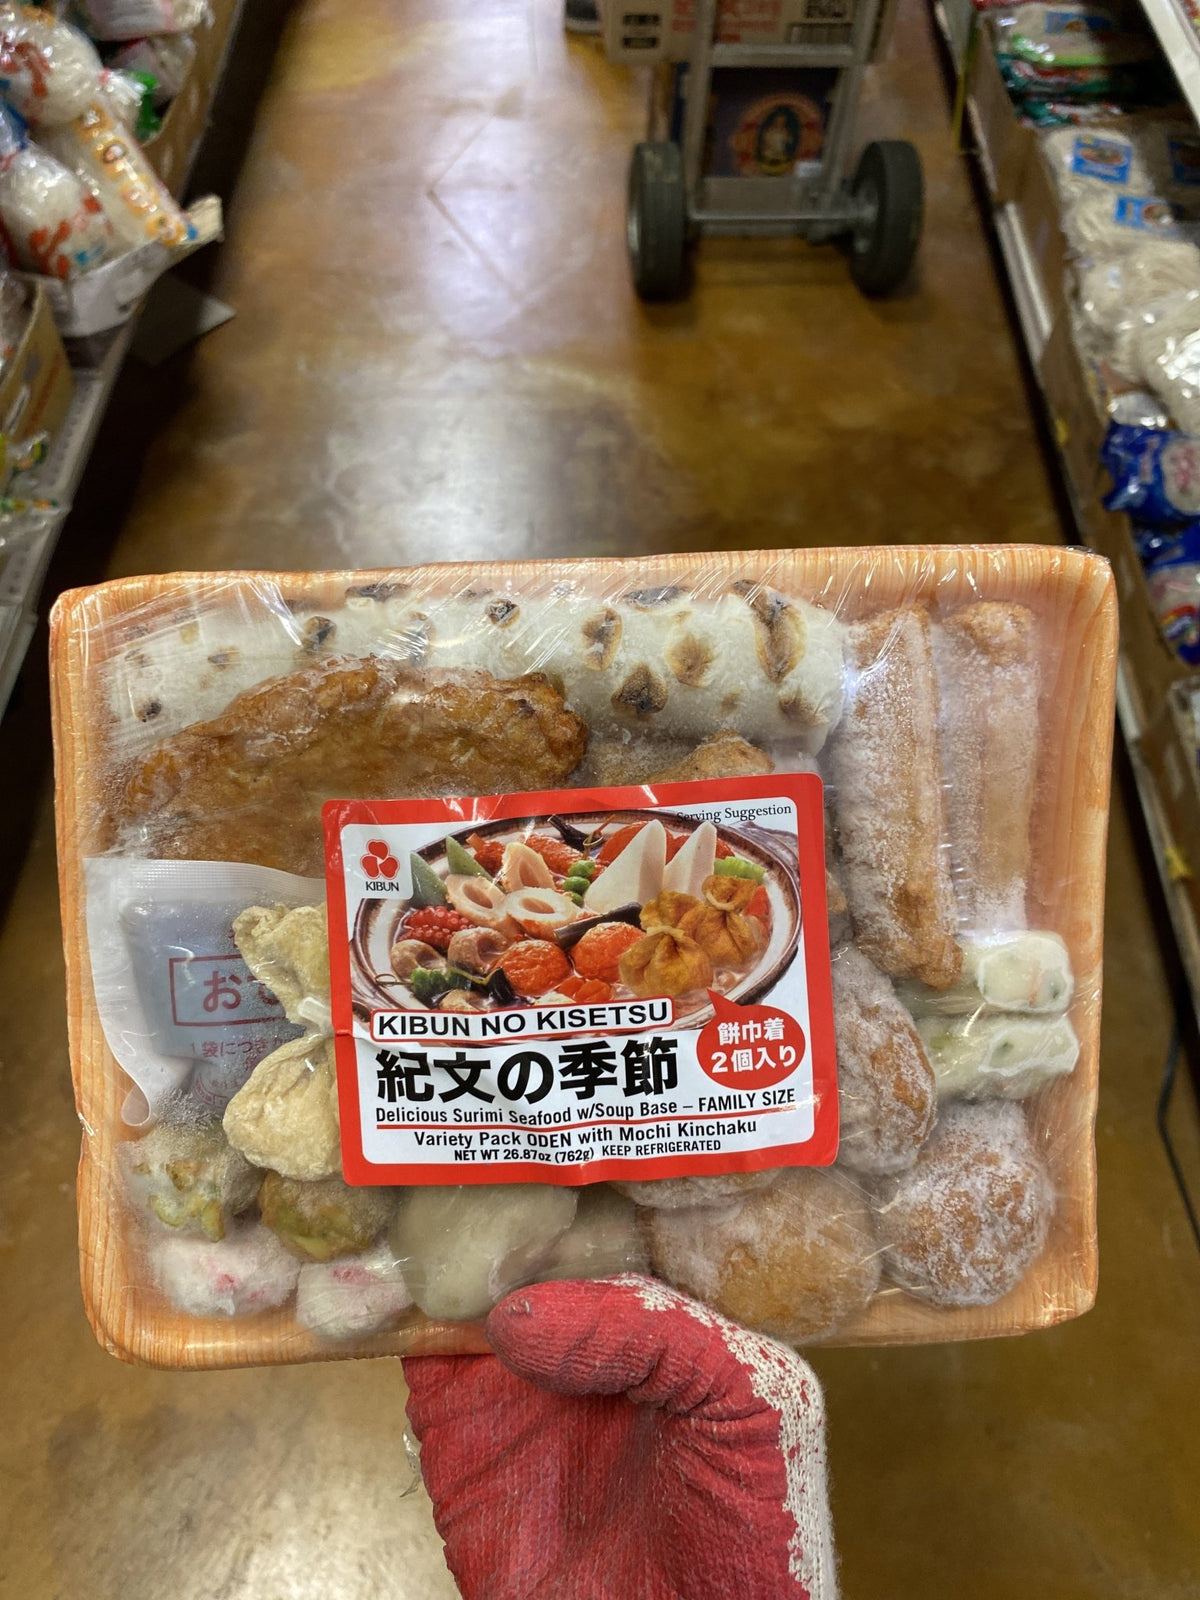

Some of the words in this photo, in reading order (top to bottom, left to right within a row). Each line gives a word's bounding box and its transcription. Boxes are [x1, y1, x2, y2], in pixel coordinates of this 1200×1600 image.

[677, 810, 722, 823] Serving
[725, 804, 792, 821] Suggestion
[366, 881, 399, 891] KIBUN
[378, 1015, 470, 1036] KIBUN
[481, 1013, 526, 1036] NO
[537, 1002, 667, 1030] KISETSU
[375, 1036, 678, 1104] 紀文の季節
[376, 1107, 447, 1122] Delicious
[453, 1108, 503, 1123] Surimi
[509, 1107, 571, 1125] Seafood
[577, 1103, 634, 1121] w/Soup
[640, 1101, 677, 1117] Base
[699, 1093, 757, 1112] FAMILY
[762, 1088, 795, 1106] SIZE
[414, 1131, 472, 1149] Variety
[480, 1131, 521, 1145] Pack
[527, 1132, 571, 1148] ODEN
[578, 1127, 613, 1144] with
[620, 1123, 671, 1141] Mochi
[677, 1120, 757, 1137] Kinchaku
[454, 1150, 476, 1161] NET
[481, 1149, 499, 1160] WT
[503, 1149, 551, 1162] 26.87oz
[555, 1149, 594, 1163] (762g)
[602, 1145, 631, 1157] KEEP
[635, 1139, 721, 1156] REFRIGERATED
